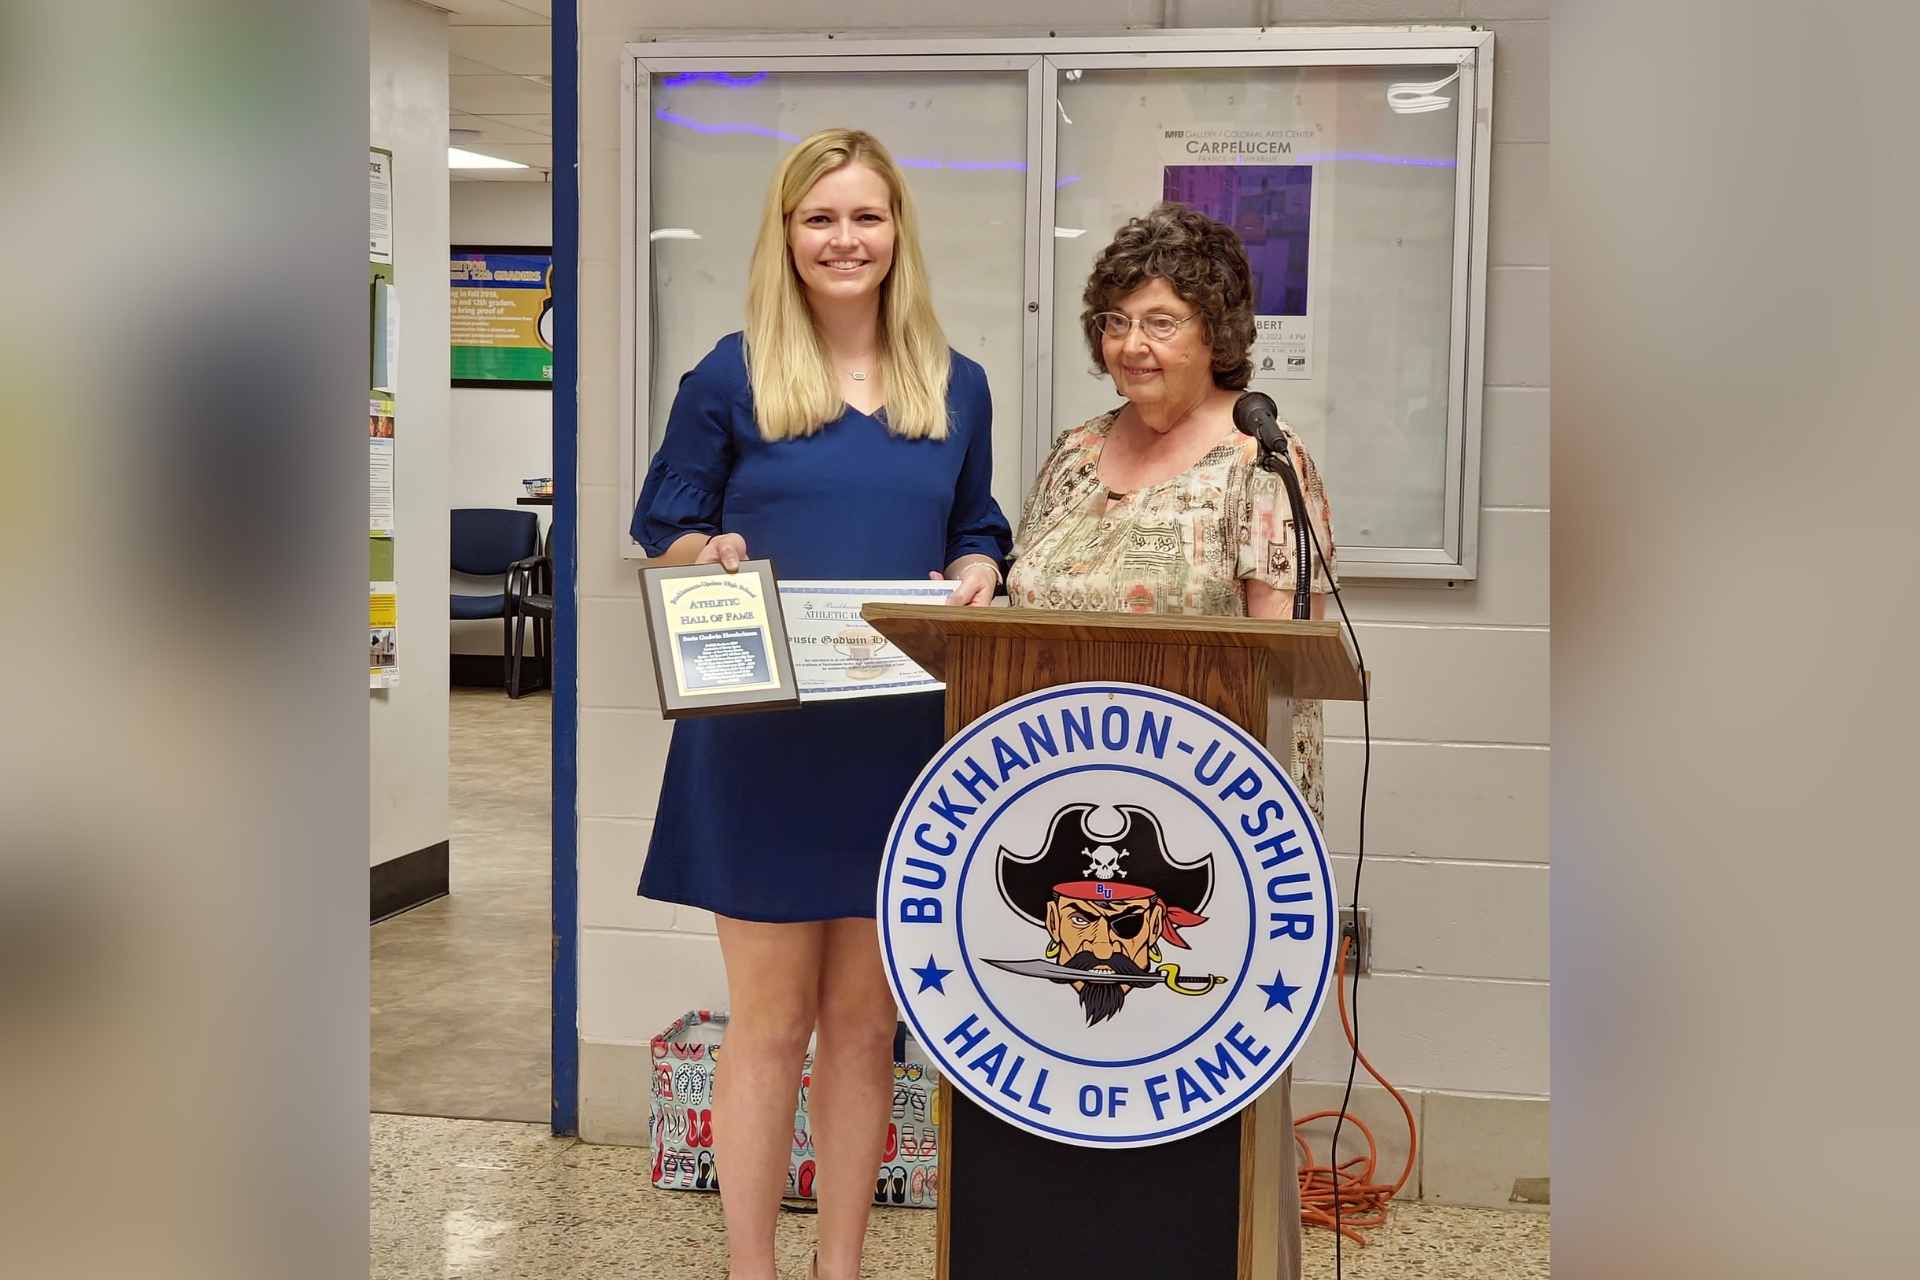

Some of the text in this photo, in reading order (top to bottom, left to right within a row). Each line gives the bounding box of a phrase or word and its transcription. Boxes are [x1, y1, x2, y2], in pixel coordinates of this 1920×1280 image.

[689, 598, 741, 610] ATHLETIC
[681, 611, 755, 625] HALL OF FAME
[804, 611, 848, 619] ATHLETIC
[900, 705, 1315, 941] BUCKHANNON-UPSHUR
[943, 1013, 1272, 1121] HALL OF FAME
